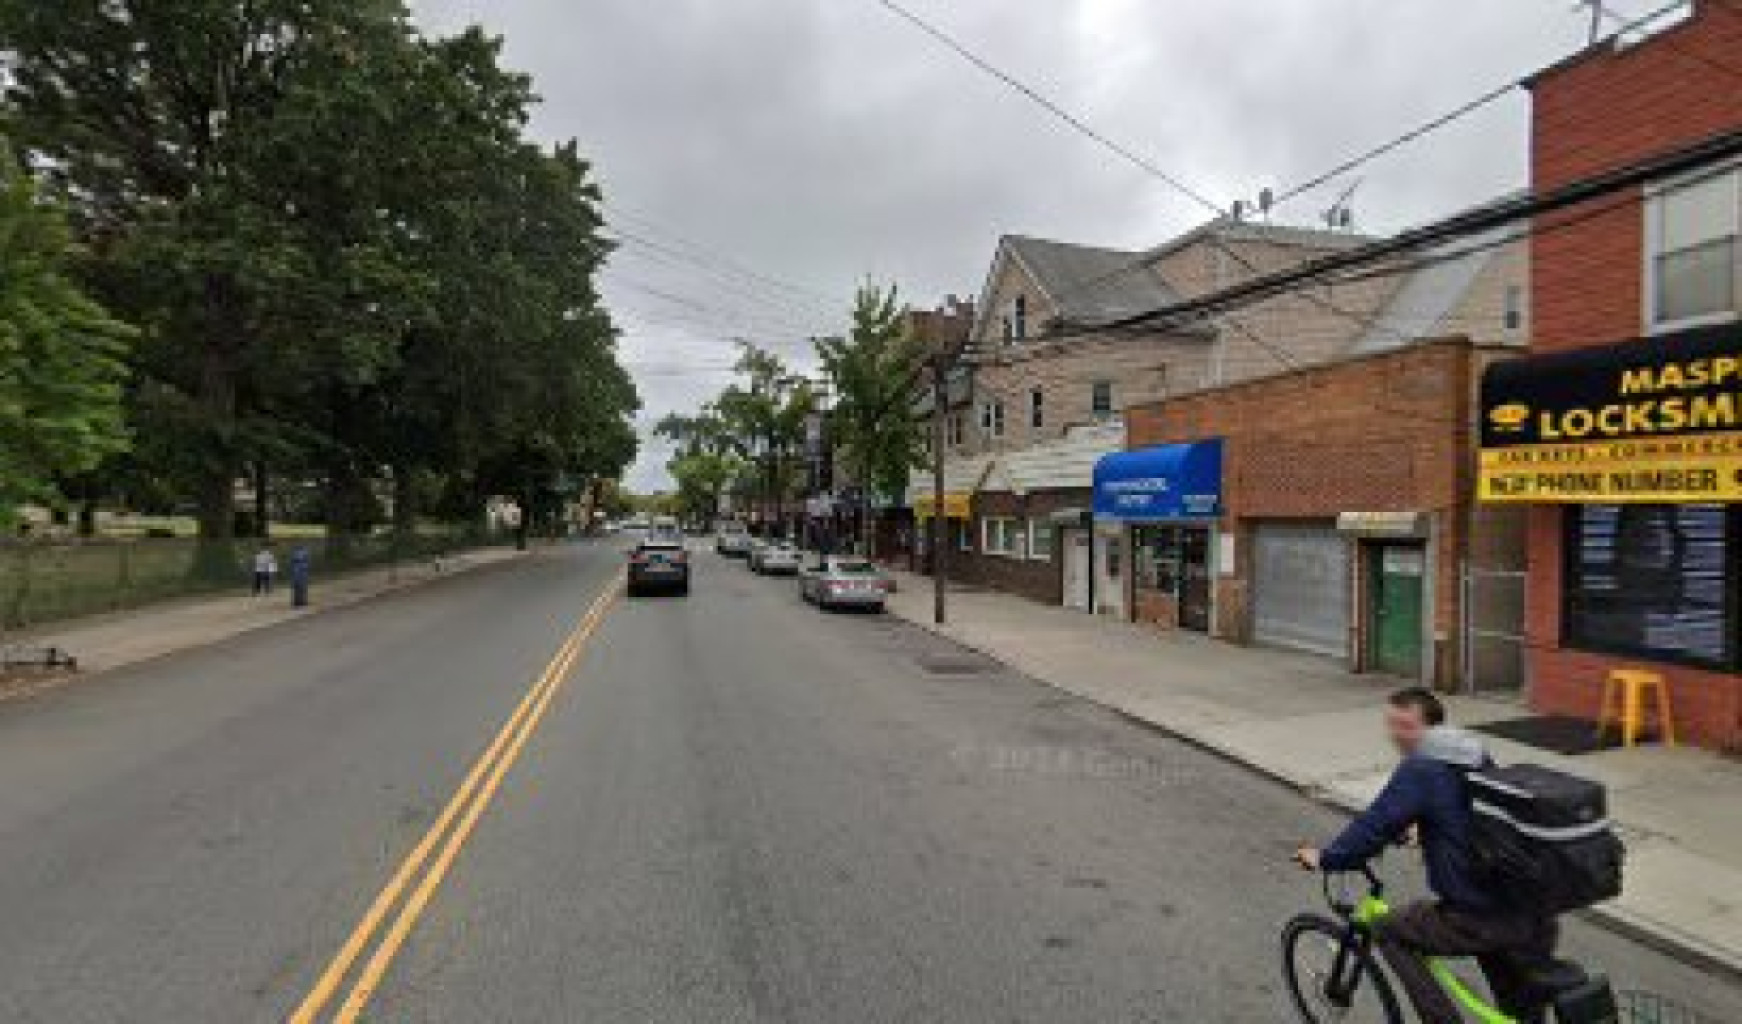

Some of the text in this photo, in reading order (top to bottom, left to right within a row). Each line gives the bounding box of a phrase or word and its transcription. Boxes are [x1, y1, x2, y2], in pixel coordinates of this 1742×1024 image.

[1621, 356, 1742, 394] MASP
[1540, 391, 1742, 439] LOCKSM
[1536, 473, 1603, 492] PHONE
[1608, 468, 1718, 491] NUMBER
